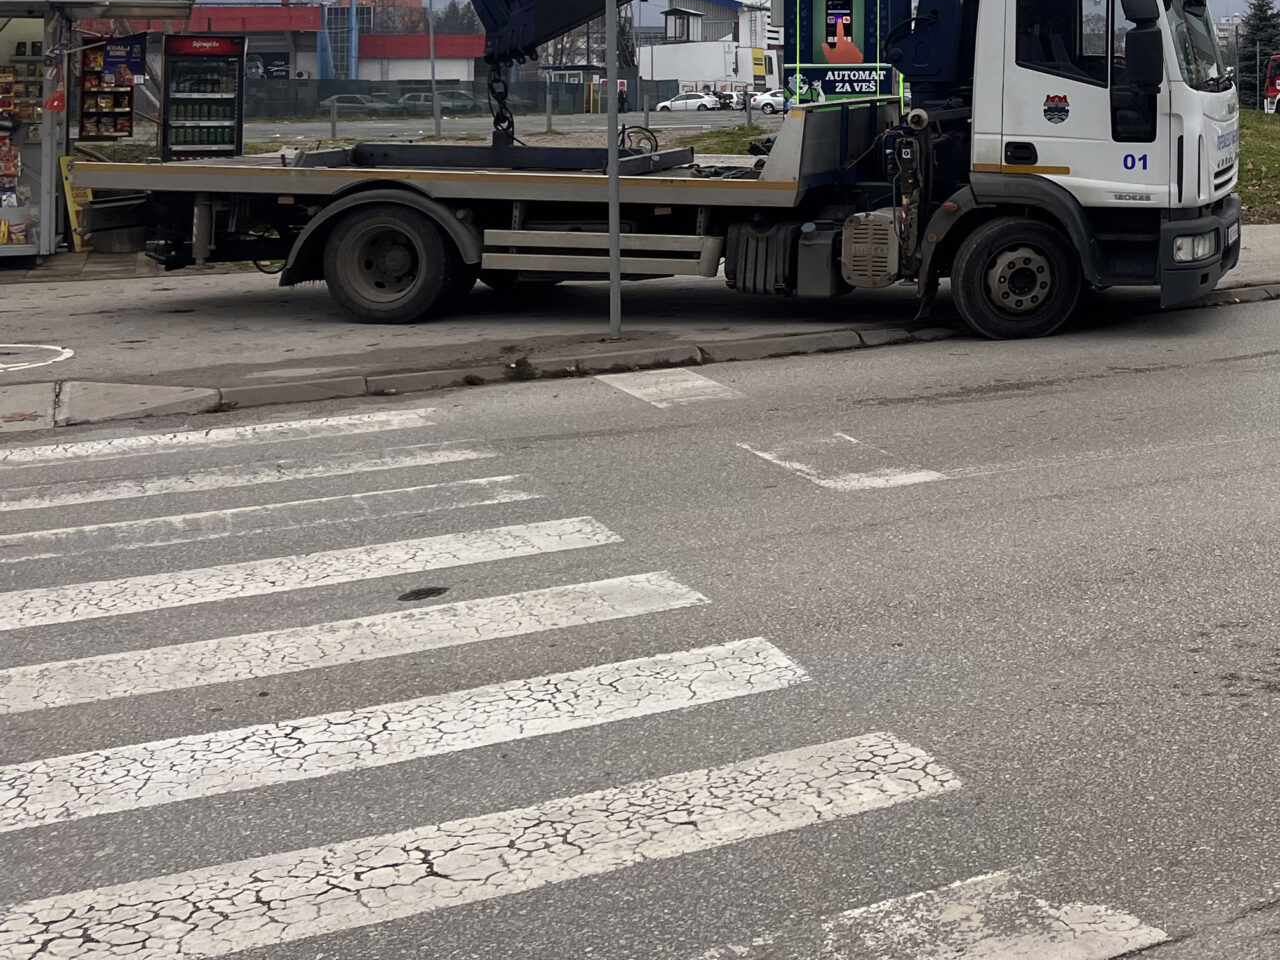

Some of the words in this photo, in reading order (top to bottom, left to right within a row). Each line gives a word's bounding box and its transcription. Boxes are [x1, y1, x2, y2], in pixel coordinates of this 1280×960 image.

[825, 70, 887, 81] AUTOMAT
[835, 82, 852, 92] ZA
[853, 80, 877, 92] VEŠ
[1123, 154, 1148, 170] 01
